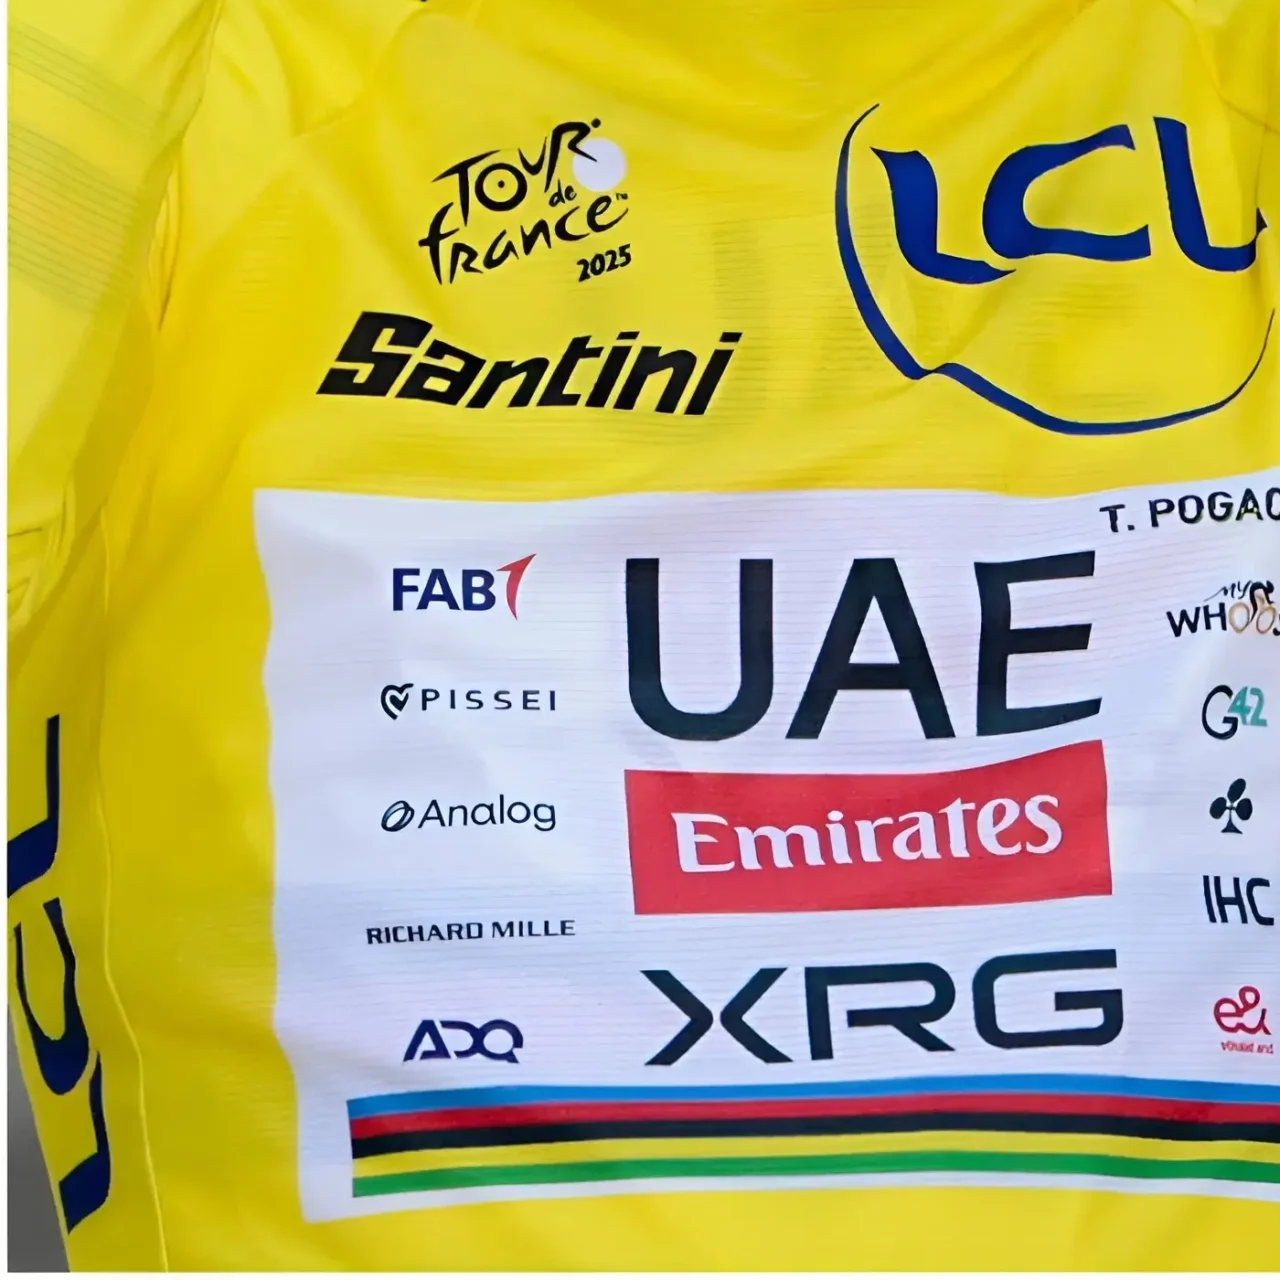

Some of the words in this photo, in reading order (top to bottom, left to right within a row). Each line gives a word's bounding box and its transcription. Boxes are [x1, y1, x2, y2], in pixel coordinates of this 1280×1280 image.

[549, 181, 577, 207] de
[869, 116, 1268, 285] LCL
[577, 244, 633, 283] 2025
[316, 311, 743, 416] Santini
[1100, 503, 1136, 533] T.
[392, 563, 510, 613] FAB
[626, 550, 1102, 742] UAE
[421, 689, 557, 712] PISSEI
[1201, 684, 1269, 740] G42
[417, 794, 557, 832] Analog
[671, 793, 1063, 874] Emirates
[1202, 875, 1275, 926] IHC
[366, 922, 484, 946] RICHARD
[491, 920, 576, 939] MILLE
[639, 949, 1125, 1066] XRG
[403, 1019, 524, 1064] ADQ
